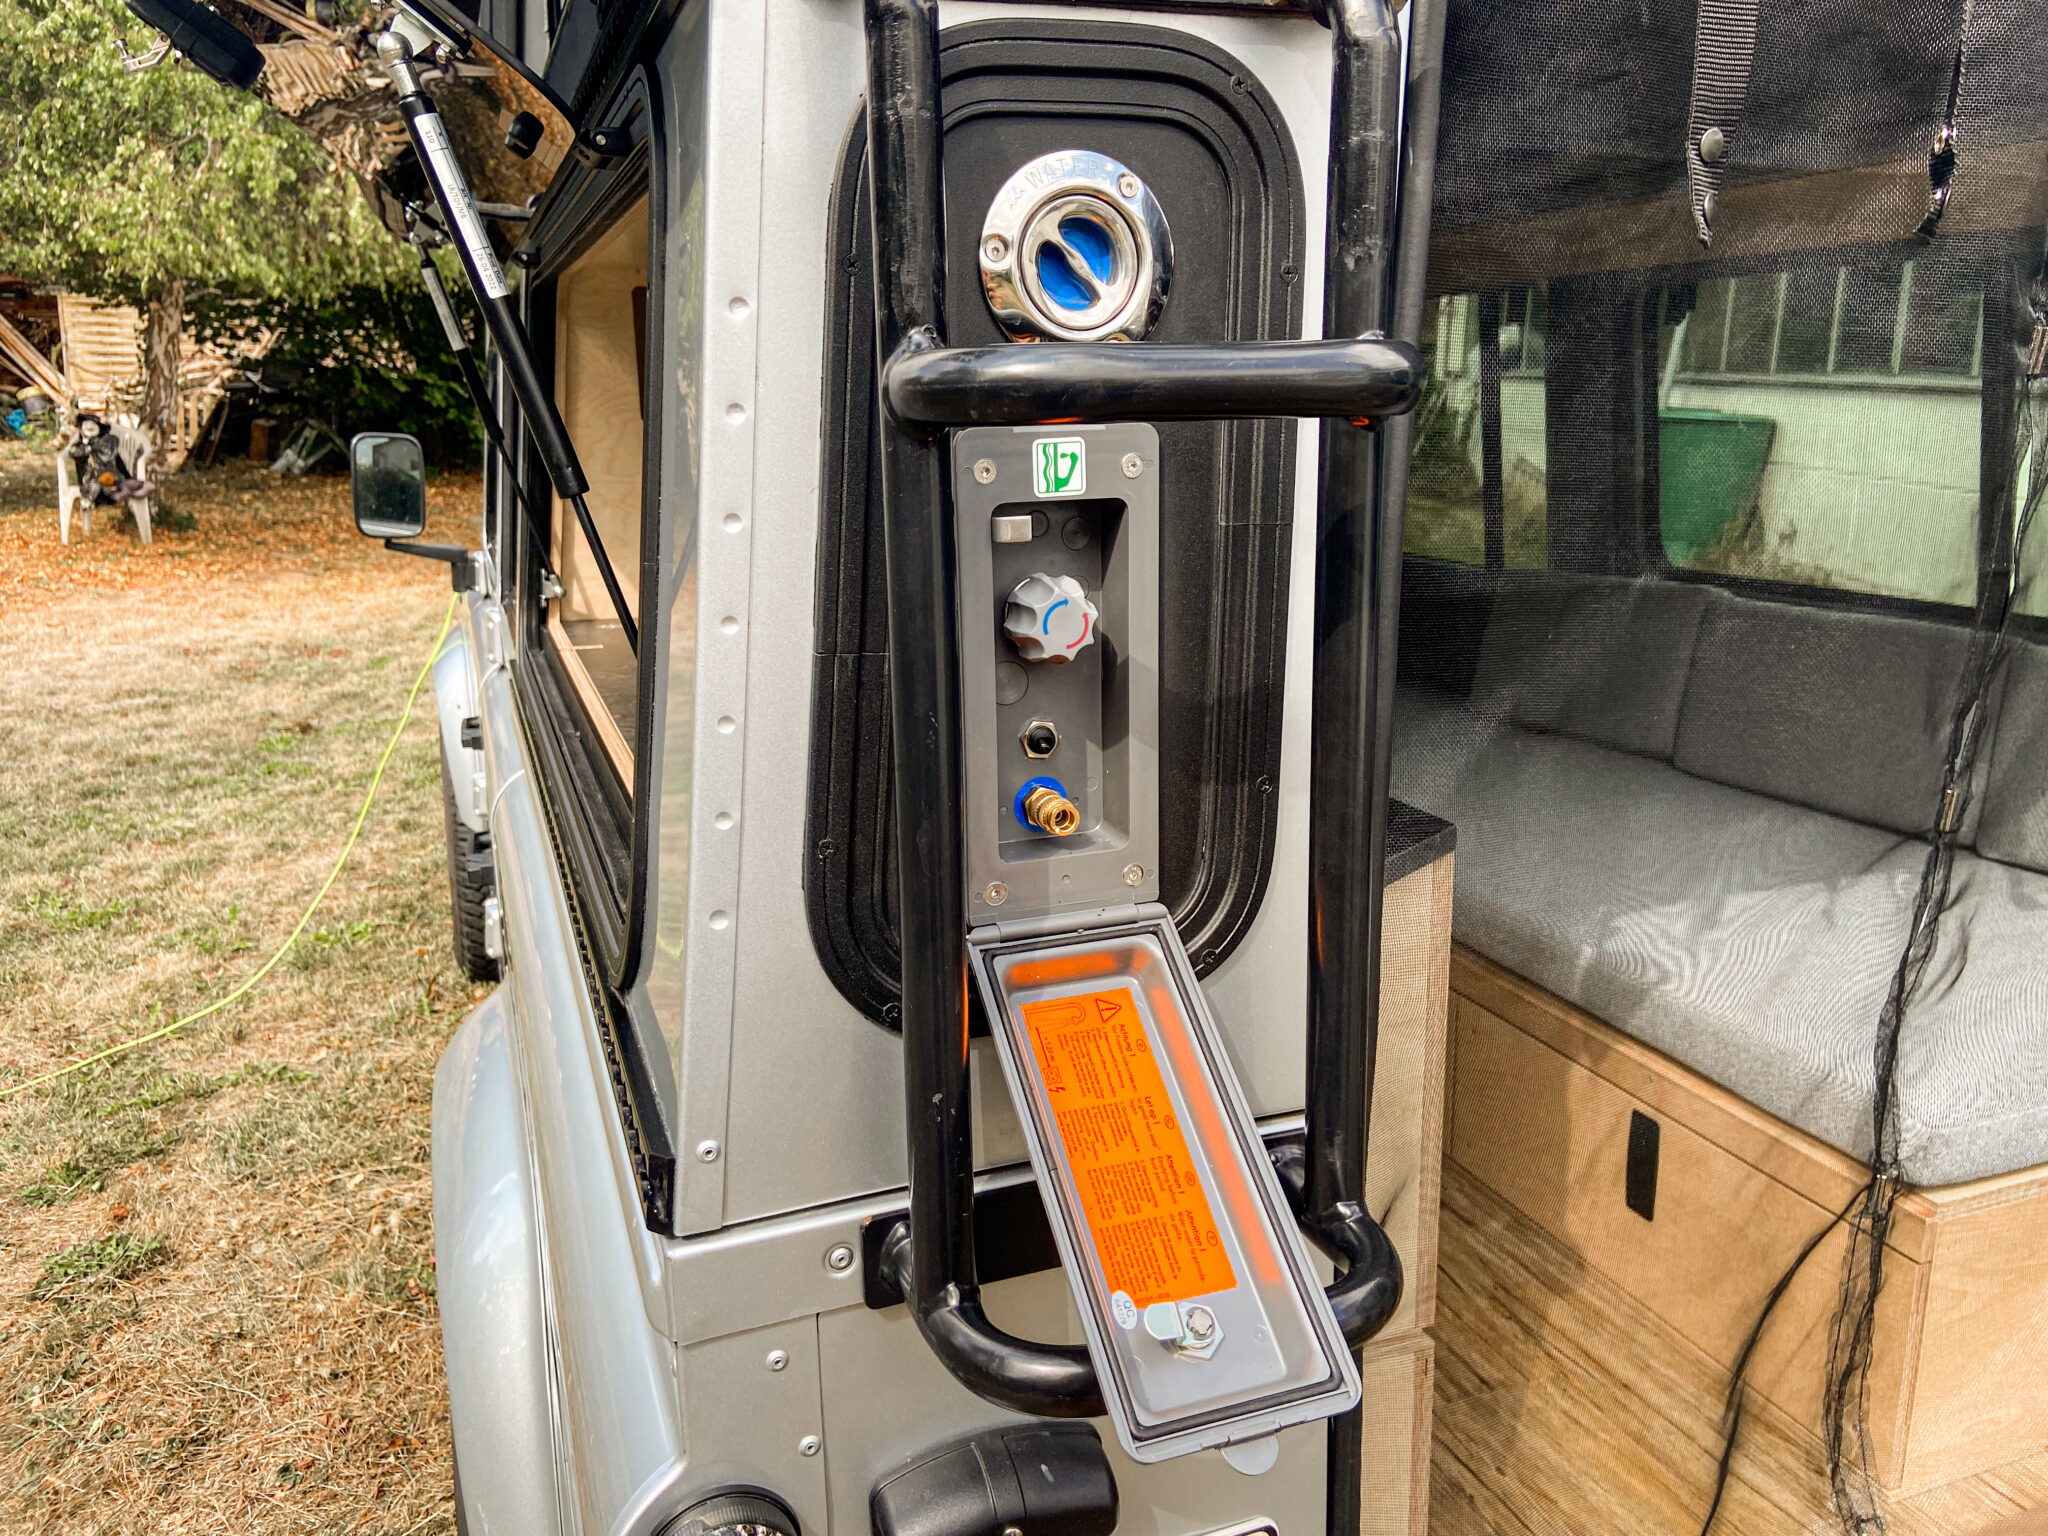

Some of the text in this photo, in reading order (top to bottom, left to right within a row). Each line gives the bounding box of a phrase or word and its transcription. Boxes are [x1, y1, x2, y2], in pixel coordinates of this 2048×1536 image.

[425, 130, 435, 144] 110
[1023, 156, 1100, 188] WATER
[1116, 1022, 1134, 1052] Achtung
[1143, 1095, 1155, 1108] Let
[1147, 1108, 1157, 1120] op
[1164, 1153, 1183, 1189] Attention
[1184, 1208, 1204, 1246] Attention
[1123, 1300, 1135, 1317] QC
